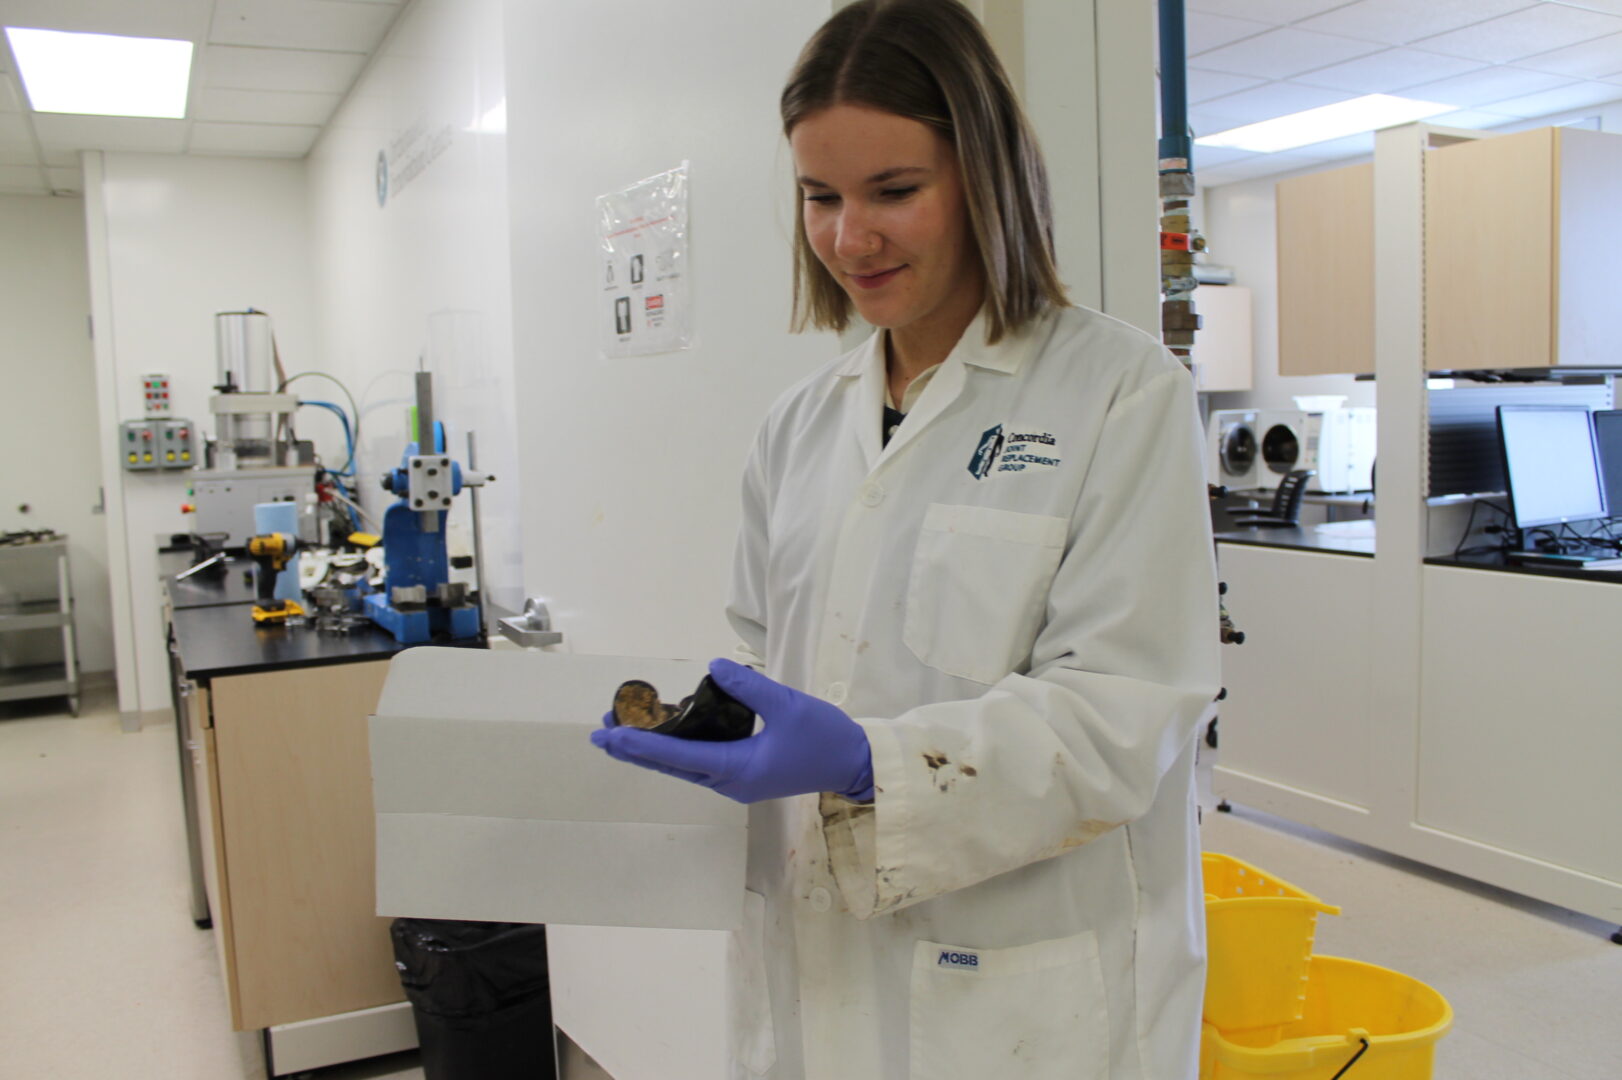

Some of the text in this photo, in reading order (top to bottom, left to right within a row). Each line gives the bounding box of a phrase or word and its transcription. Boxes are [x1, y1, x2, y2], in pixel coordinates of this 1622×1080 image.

[1007, 432, 1056, 446] Concordia
[1004, 444, 1027, 453] JOINT
[1001, 454, 1061, 467] REPLACEMENT
[998, 463, 1027, 472] GROUP
[938, 951, 978, 966] MOBB
